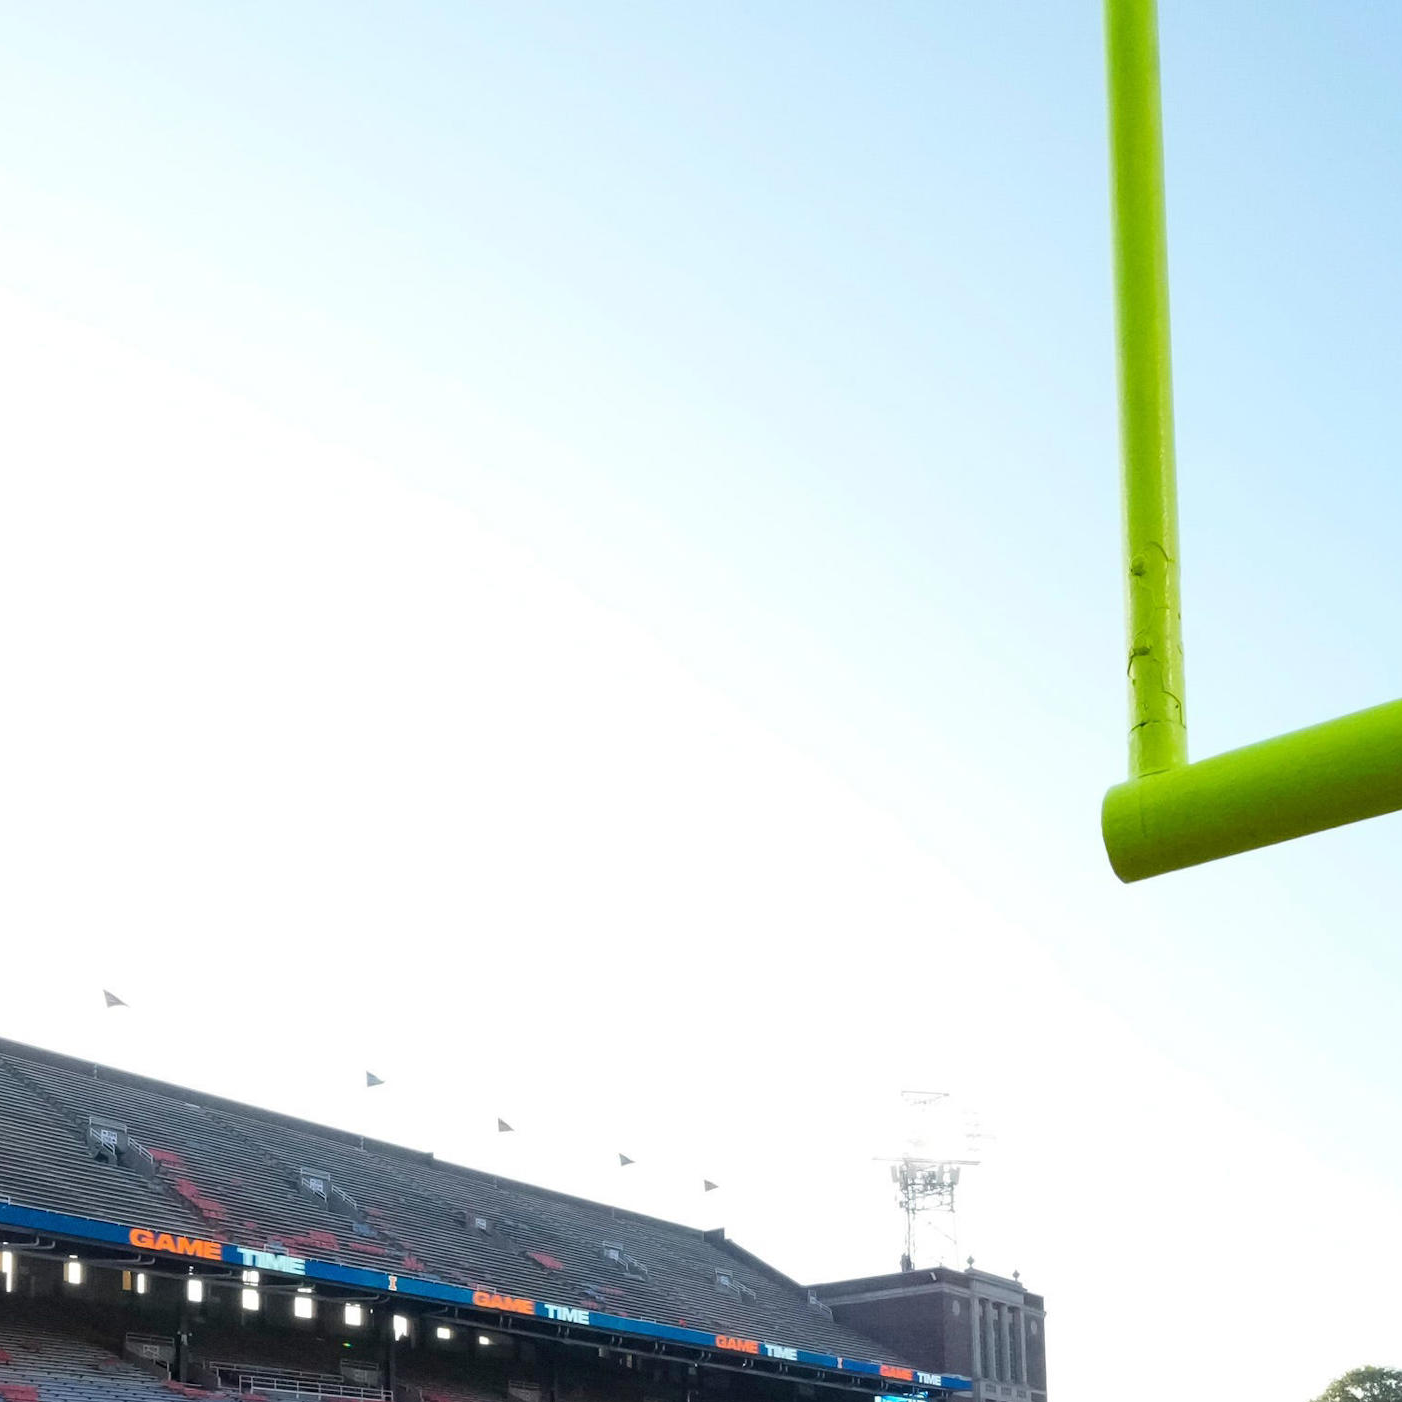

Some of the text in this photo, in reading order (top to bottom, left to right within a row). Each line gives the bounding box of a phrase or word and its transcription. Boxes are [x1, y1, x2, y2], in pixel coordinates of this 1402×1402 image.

[129, 1228, 306, 1276] GAME TIME
[472, 1291, 590, 1326] GAME TIME
[715, 1334, 798, 1361] GAME TIME
[917, 1371, 942, 1386] TIME
